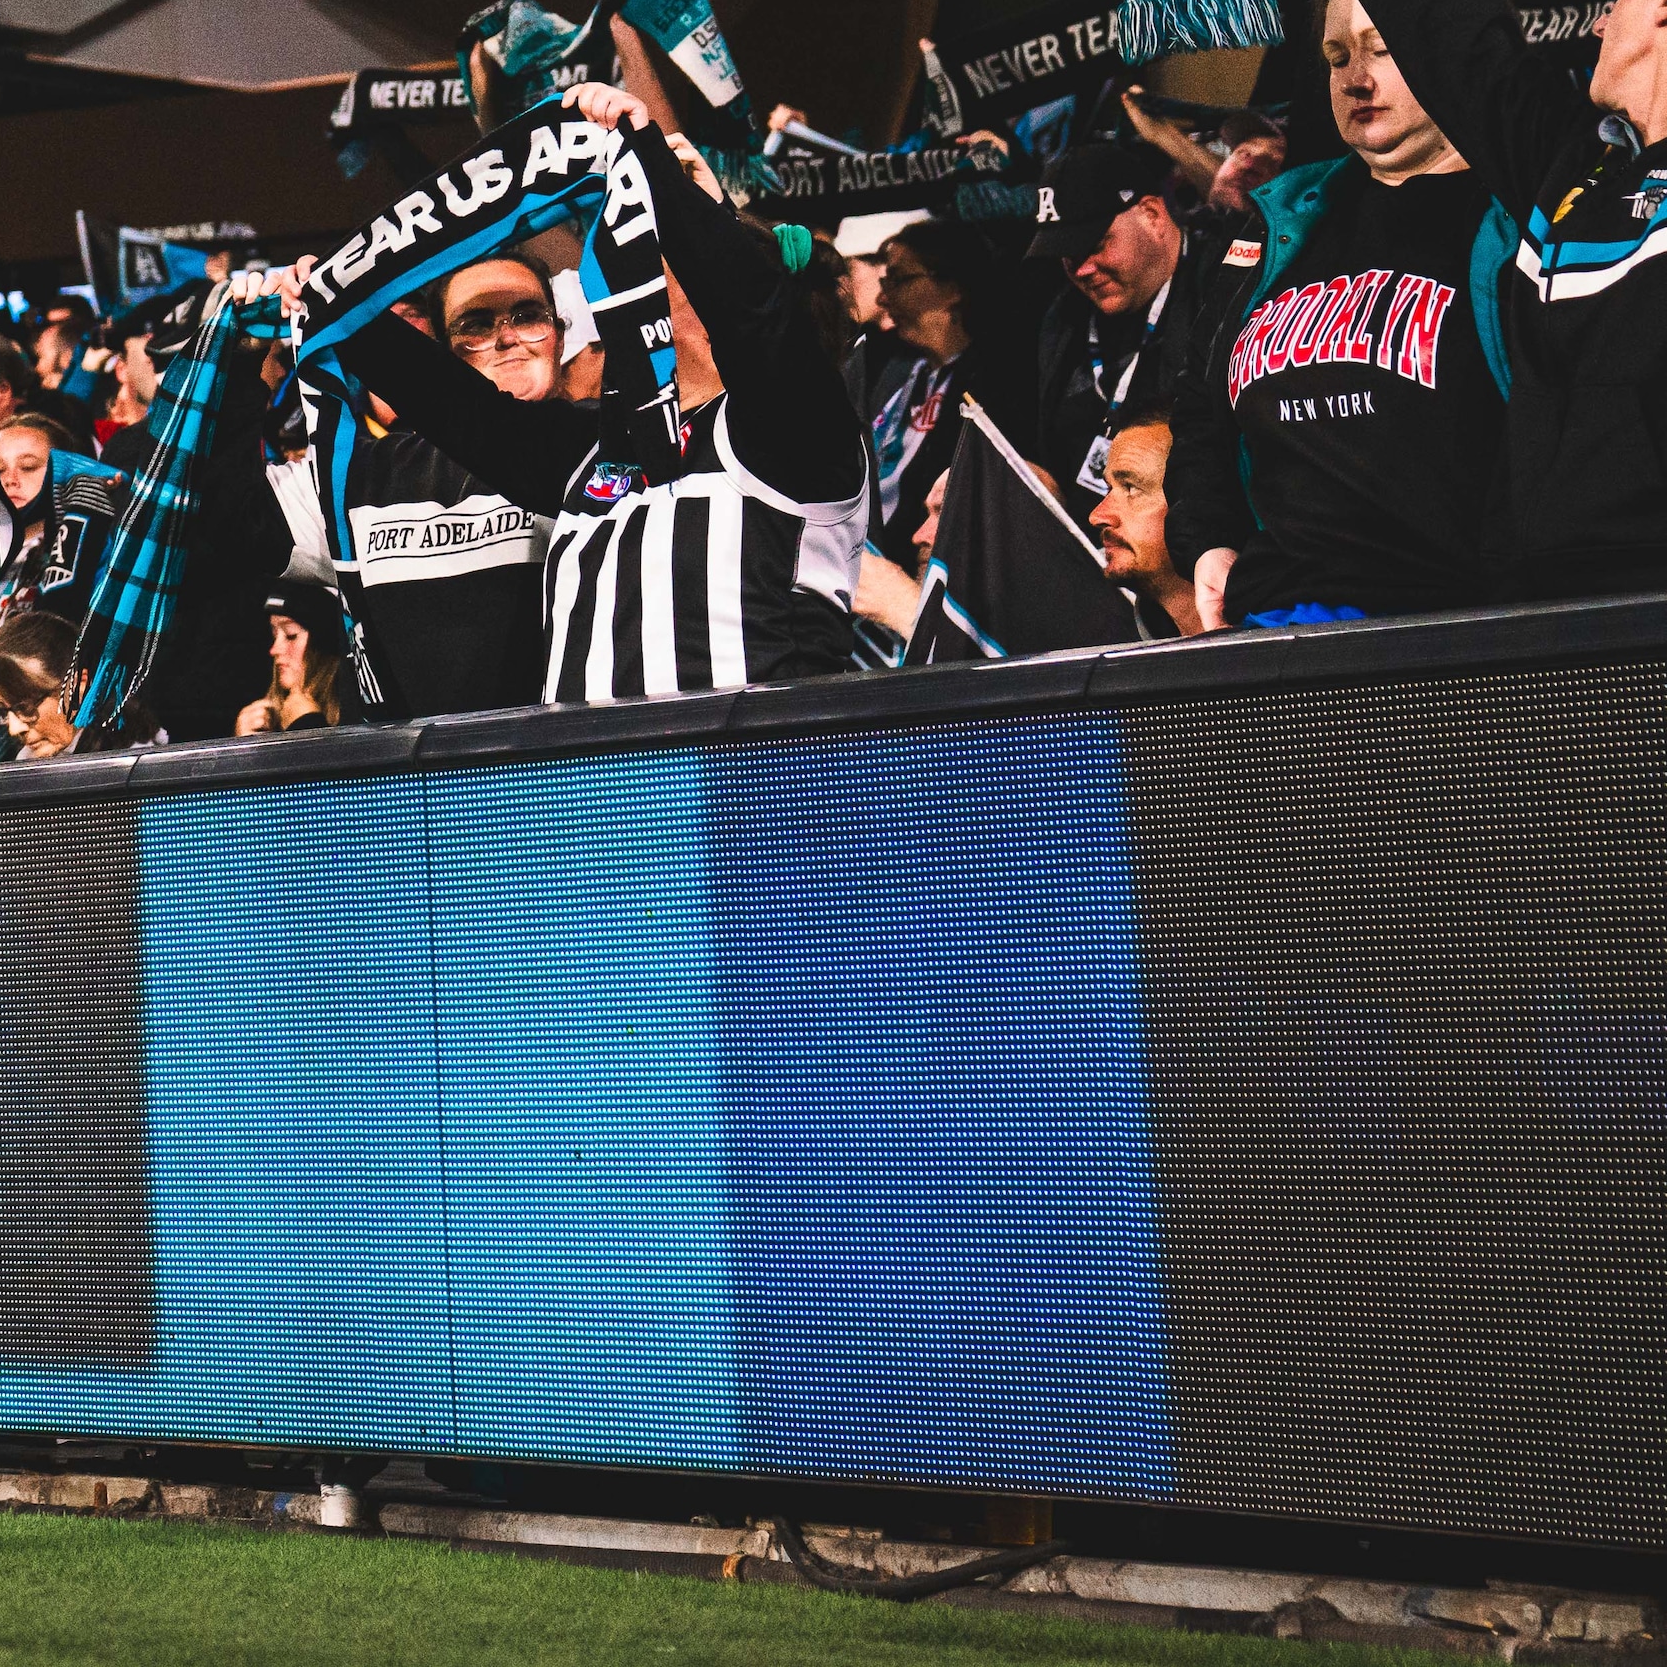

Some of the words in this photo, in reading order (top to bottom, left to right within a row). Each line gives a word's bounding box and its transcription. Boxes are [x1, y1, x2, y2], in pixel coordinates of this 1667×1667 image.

[964, 33, 1066, 99] NEVER
[370, 79, 436, 109] NEVER
[302, 190, 444, 304] TEAR
[436, 148, 515, 218] US
[1227, 268, 1457, 411] BROOKLYN
[1279, 398, 1317, 422] NEW
[1325, 390, 1376, 419] YORK
[367, 526, 415, 555] PORT
[419, 511, 536, 549] ADELAIDE
